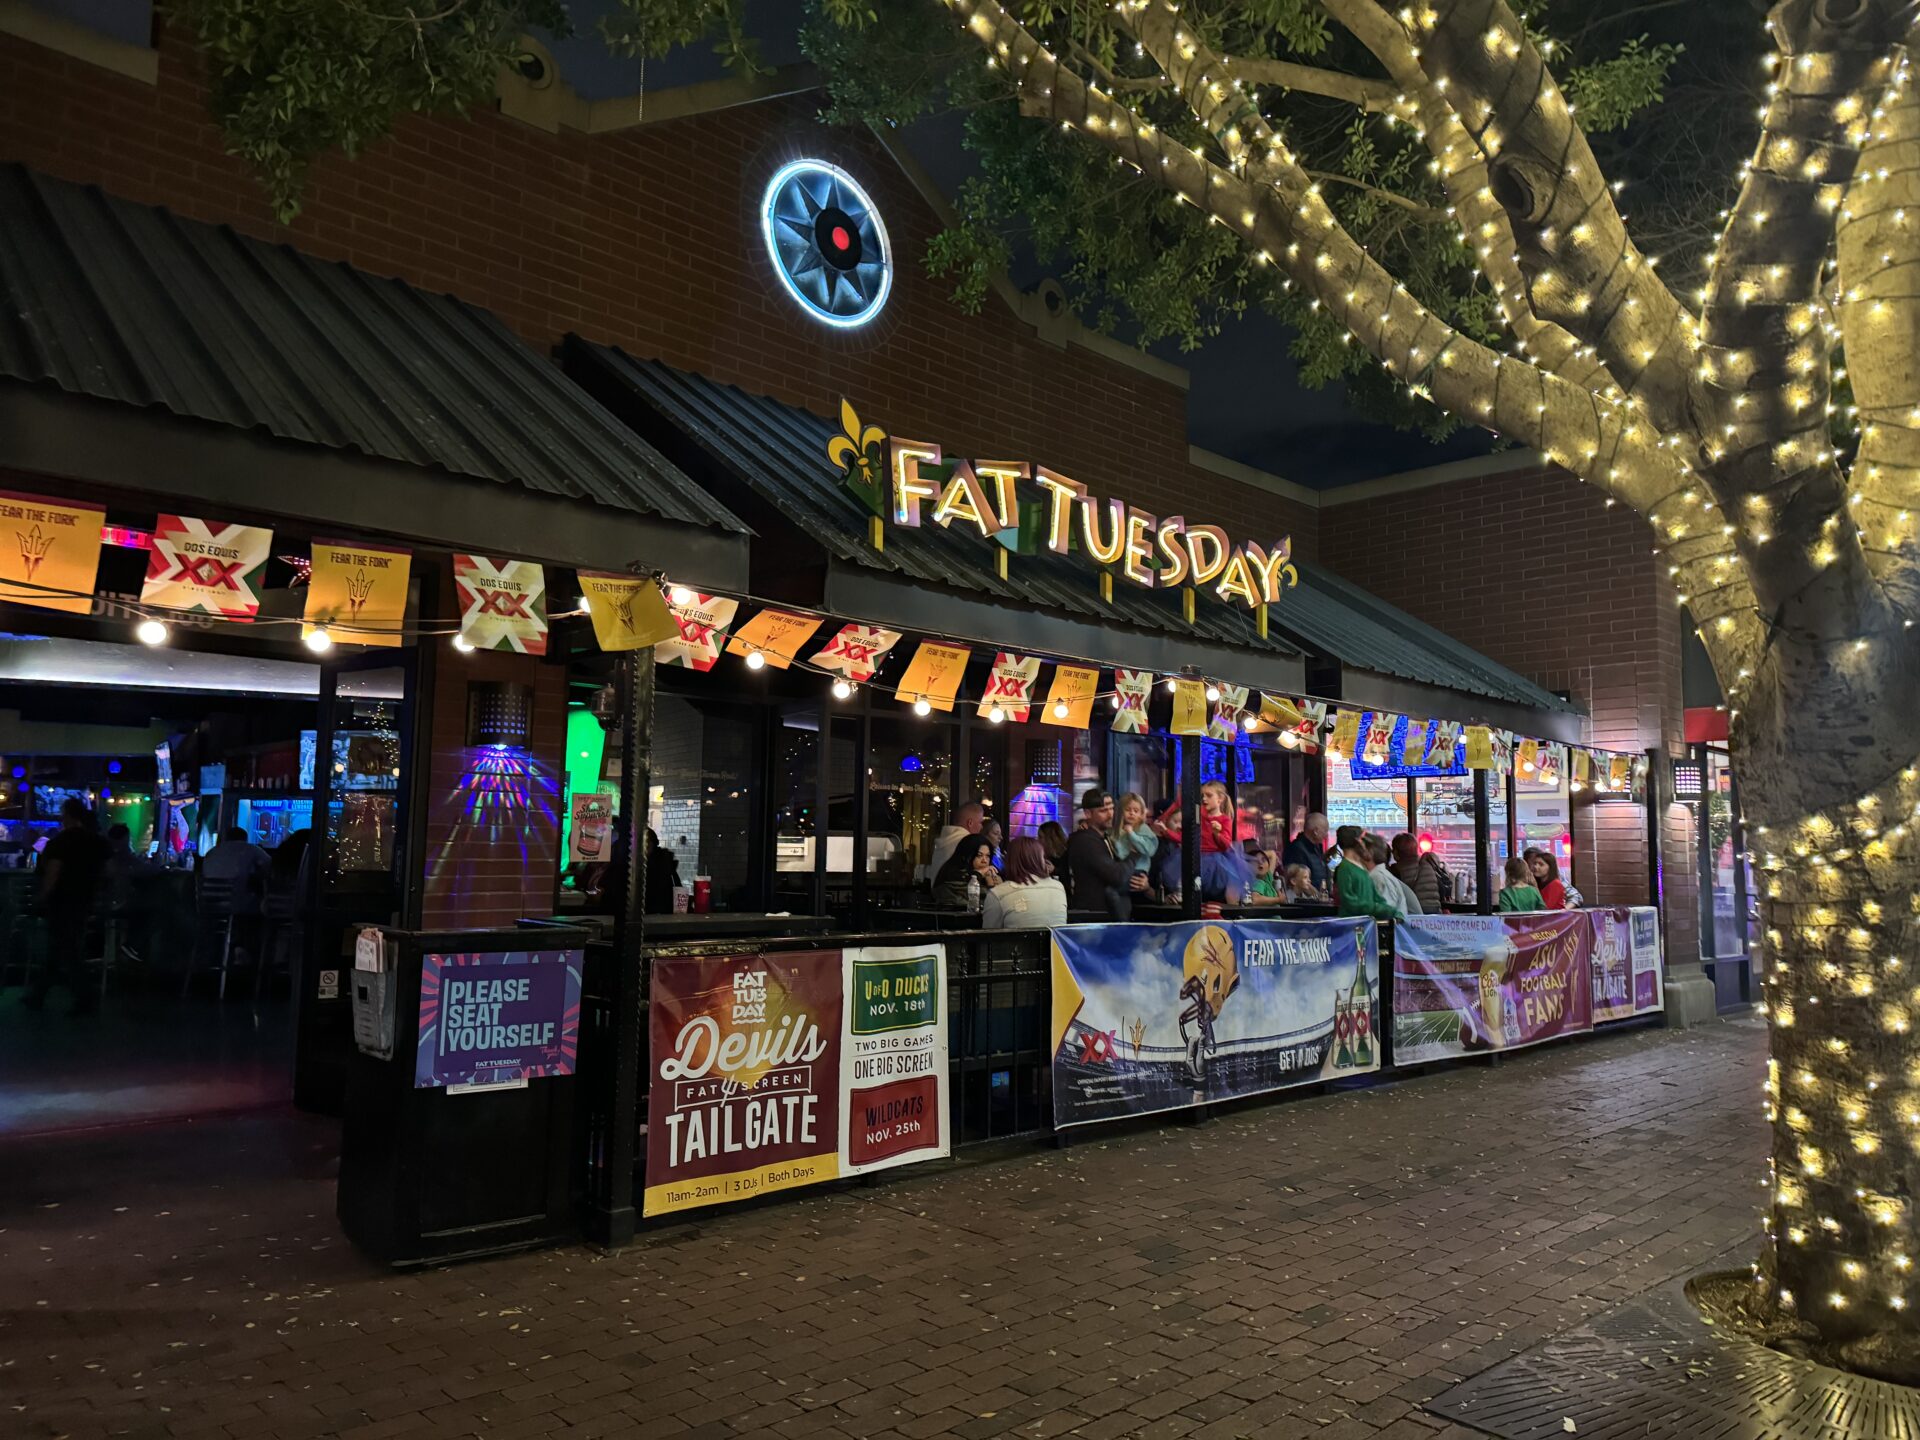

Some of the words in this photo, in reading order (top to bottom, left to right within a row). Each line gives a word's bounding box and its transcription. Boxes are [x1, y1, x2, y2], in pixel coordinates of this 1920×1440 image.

[26, 509, 46, 522] THE
[882, 436, 1030, 538] FAT
[1036, 464, 1290, 608] TUESDAY
[184, 542, 205, 554] DOS
[207, 545, 239, 559] EQUIS
[331, 552, 351, 564] FEAR
[353, 554, 368, 566] THE
[170, 552, 246, 592] XX
[480, 578, 497, 588] DOS
[498, 580, 521, 591] EQUIS
[592, 583, 609, 593] FEAR
[609, 584, 622, 594] THE
[474, 587, 531, 619] XX
[694, 610, 714, 622] EQUIS
[833, 641, 878, 664] XX
[995, 676, 1028, 698] XX
[1123, 692, 1145, 711] XX
[1370, 730, 1389, 745] XX
[1425, 920, 1446, 931] READY
[1446, 920, 1460, 931] FOR
[1460, 920, 1480, 931] GAME
[1481, 921, 1494, 931] DAY
[1243, 939, 1275, 968] FEAR
[1275, 938, 1300, 966] THE
[1299, 936, 1331, 963] FORK
[1529, 943, 1558, 970] ASU
[451, 978, 530, 1004] PLEASE
[733, 971, 768, 989] FAT
[895, 973, 929, 997] DUCKS
[1521, 972, 1568, 994] FOOTBALL
[733, 988, 767, 1004] TUES
[870, 1002, 898, 1017] NOV.
[904, 998, 926, 1012] 18th
[449, 1003, 502, 1029] SEAT
[732, 1003, 766, 1019] DAY
[1524, 994, 1565, 1026] FANS
[448, 1022, 555, 1052] YOURSELF
[660, 1014, 827, 1081] Devils
[855, 1041, 877, 1052] TWO
[880, 1038, 899, 1049] BIG
[903, 1034, 934, 1047] GAMES
[1080, 1030, 1119, 1065] XX
[490, 1058, 522, 1067] TUESDAY
[854, 1059, 875, 1079] ONE
[877, 1056, 893, 1076] BIG
[896, 1051, 934, 1074] SCREEN
[1279, 1050, 1296, 1071] GET
[687, 1085, 717, 1099] FAT
[741, 1074, 803, 1091] SCREEN
[866, 1096, 924, 1127] WILDCATS
[665, 1095, 819, 1168] TAILGATE
[866, 1126, 893, 1145] NOV.
[896, 1122, 921, 1137] 25th
[667, 1185, 719, 1204] 11am-2am
[733, 1180, 741, 1192] 3
[743, 1177, 758, 1190] DJs
[768, 1170, 791, 1184] Both
[792, 1166, 815, 1182] Days
